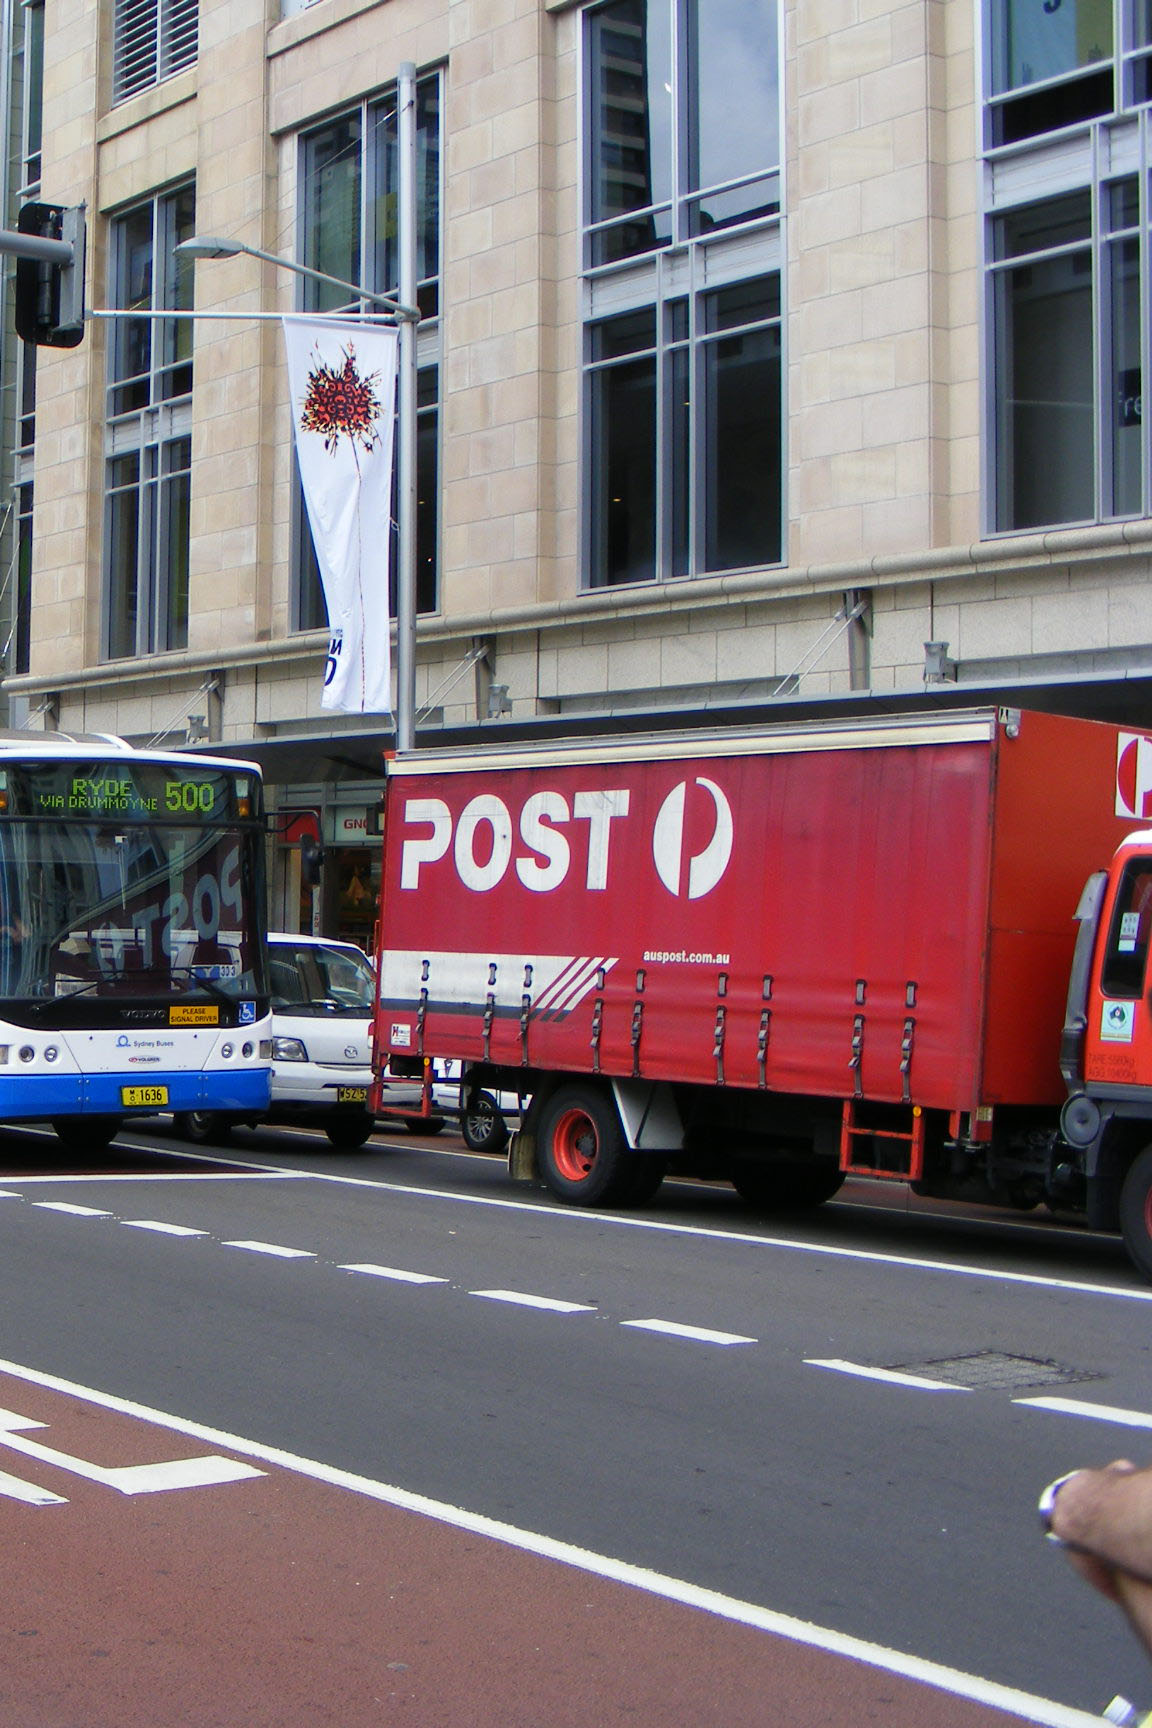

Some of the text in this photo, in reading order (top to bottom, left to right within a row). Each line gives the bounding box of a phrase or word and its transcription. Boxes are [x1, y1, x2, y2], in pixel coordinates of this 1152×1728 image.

[72, 778, 133, 797] RYDE
[39, 795, 158, 811] VIA DRUMMOYNE
[165, 782, 215, 812] 500
[400, 789, 630, 892] POST
[643, 950, 730, 964] auspost.com.au
[182, 1007, 206, 1015] PLEASE
[170, 1015, 218, 1023] SIGNAL DRIVER
[133, 1040, 155, 1048] Sydney
[139, 1089, 163, 1101] 1636
